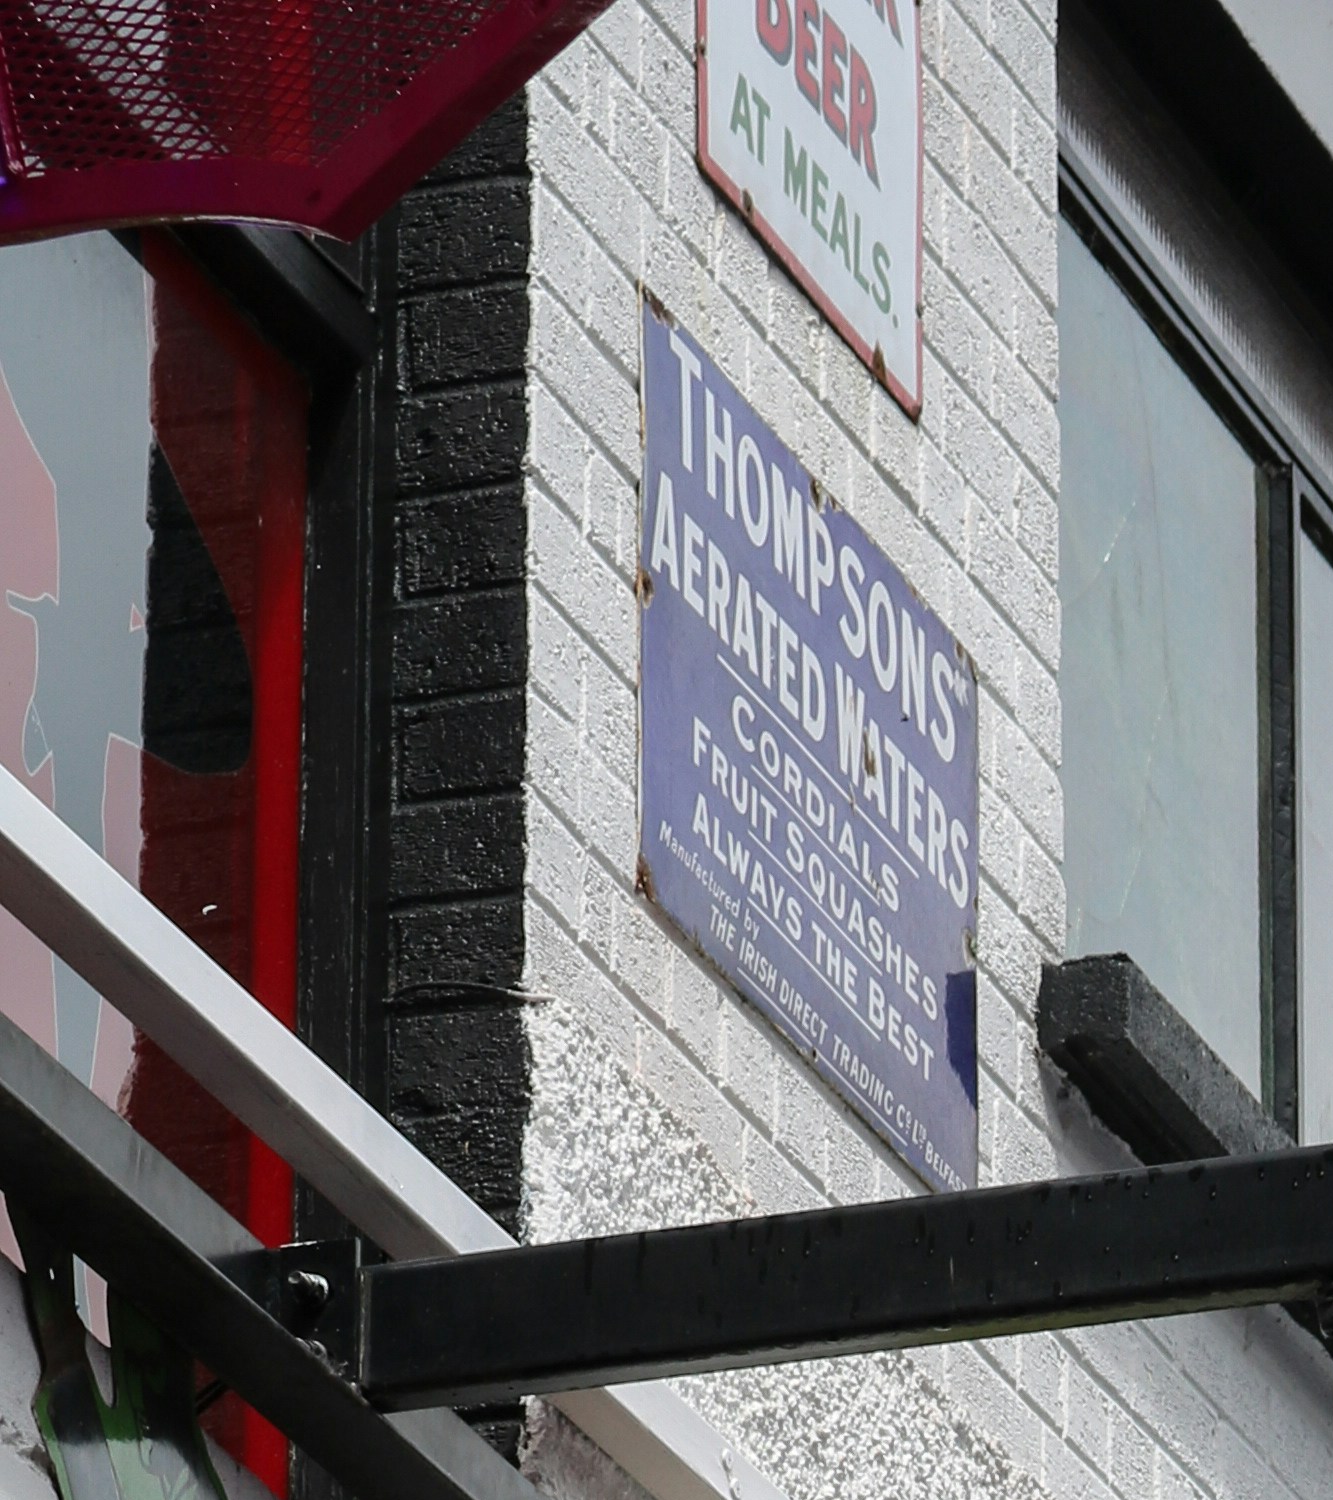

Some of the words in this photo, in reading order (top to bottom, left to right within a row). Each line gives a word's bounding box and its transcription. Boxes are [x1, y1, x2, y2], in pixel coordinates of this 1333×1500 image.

[730, 72, 770, 166] AT
[784, 126, 899, 328] MEALS.
[651, 472, 826, 742] AERATED
[834, 661, 969, 909] WATERS
[732, 695, 900, 912] CORDIALS
[658, 820, 741, 919] Manufactured
[743, 909, 761, 941] by
[692, 716, 777, 843] FRUIT
[786, 821, 939, 1021] SQUASHES
[692, 792, 803, 941] ALWAYS
[811, 921, 858, 1004] THE
[867, 975, 935, 1082] BEST
[709, 904, 736, 952] THE
[738, 934, 778, 996] IRISH
[778, 976, 830, 1048] DIRECT
[832, 1034, 894, 1117] TRADING
